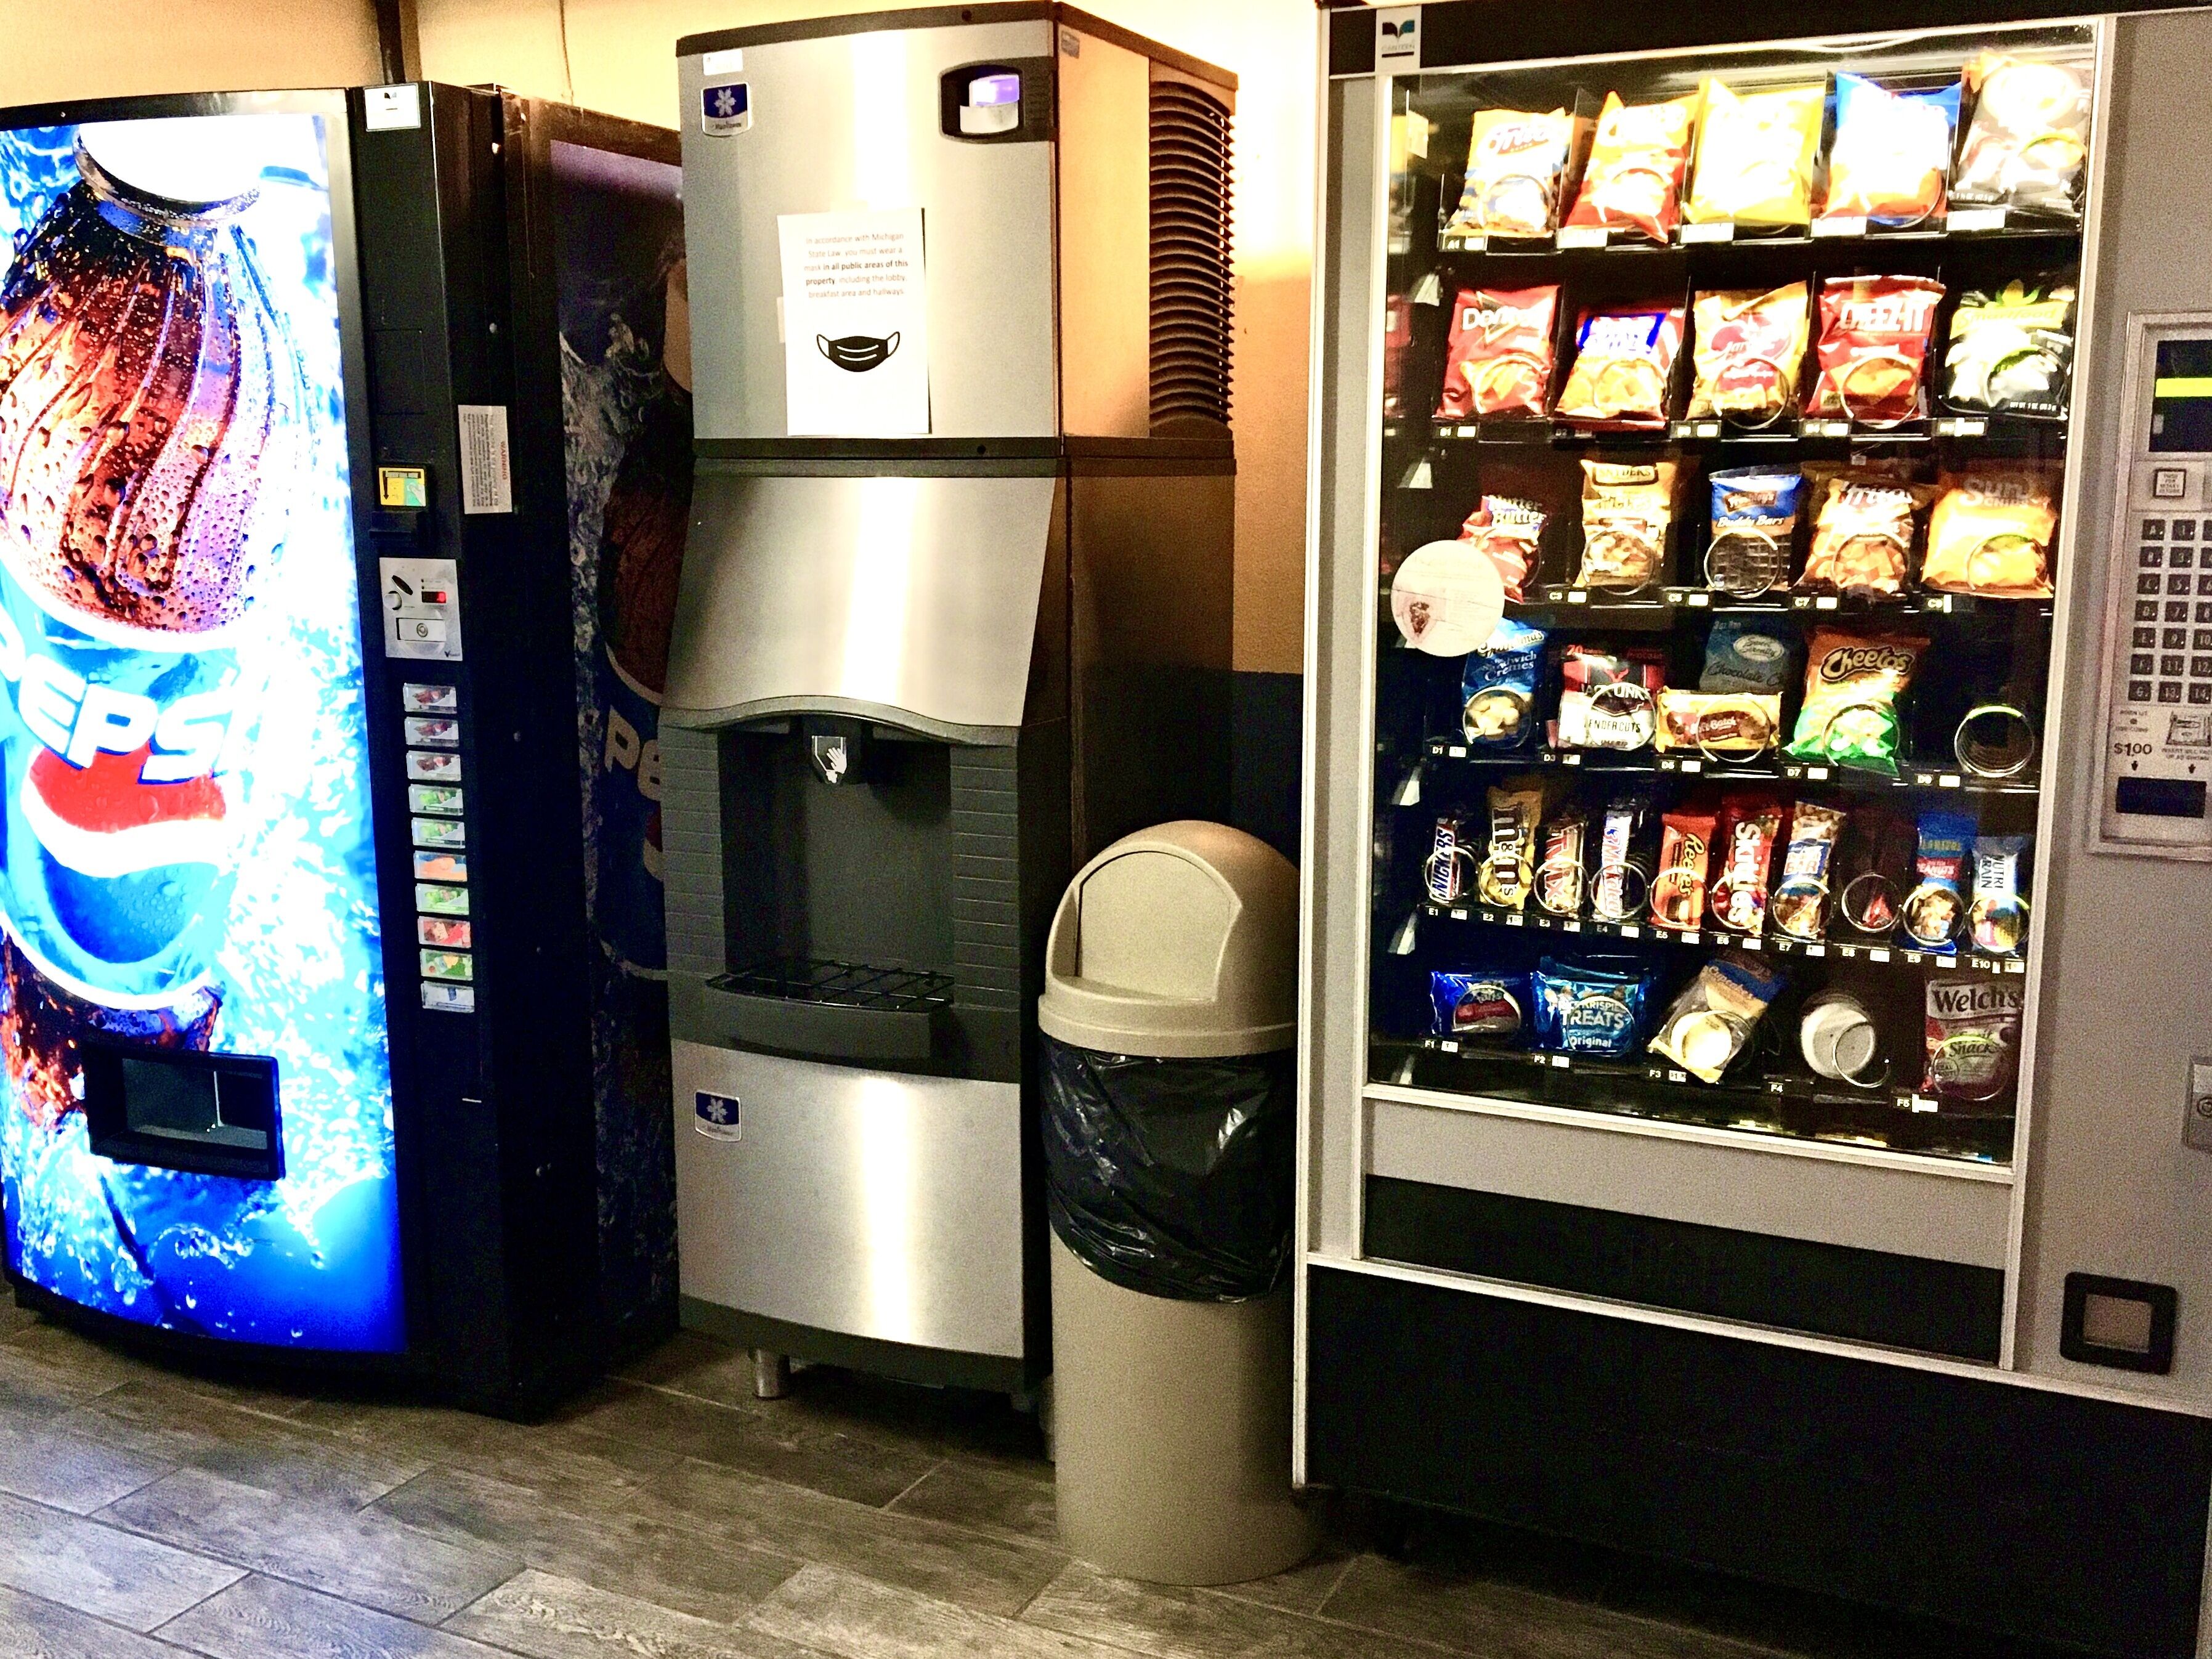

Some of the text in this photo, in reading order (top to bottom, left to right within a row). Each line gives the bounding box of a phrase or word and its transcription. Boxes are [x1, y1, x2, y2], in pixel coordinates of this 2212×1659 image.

[814, 235, 853, 245] accordance
[854, 234, 870, 242] with
[872, 232, 904, 243] Michigan
[808, 249, 826, 258] State
[845, 249, 858, 258] you
[859, 248, 877, 256] must
[803, 264, 822, 272] mask
[823, 263, 830, 271] in
[831, 262, 840, 270] all
[841, 261, 862, 272] public
[885, 259, 894, 268] of
[894, 259, 909, 267] this
[838, 275, 870, 285] including
[872, 274, 884, 282] the
[808, 290, 840, 299] breakfast
[841, 290, 856, 298] area
[858, 288, 872, 296] and
[1956, 307, 2057, 329] Smartfood
[500, 440, 508, 481] WARNING
[1838, 481, 1913, 506] Fritos
[1958, 478, 2028, 506] Sun
[1488, 494, 1543, 513] Nutter
[1491, 508, 1547, 527] Butter
[1717, 514, 1785, 528] Buddy Bars
[1481, 651, 1537, 673] Sandwich
[1820, 646, 1914, 681] Cheetos
[1484, 661, 1534, 681] Cremes
[1707, 662, 1764, 683] Chocolate
[1621, 721, 1645, 734] CUTS
[1710, 716, 1737, 729] Batch
[1432, 746, 1444, 755] D1
[2113, 742, 2152, 756] $1.00
[1544, 753, 1556, 762] D3
[1679, 833, 1706, 898] Reee's
[1991, 854, 2005, 889] NUTRI
[1727, 822, 1762, 923] Skittles
[1428, 907, 1438, 916] E1
[1483, 913, 1494, 922] E2
[1597, 924, 1608, 933] E4
[1779, 943, 1792, 951] E7
[1972, 959, 1990, 969] E10
[1560, 1009, 1625, 1030] TREATS
[1425, 1040, 1435, 1049] F1
[1569, 1036, 1612, 1049] Original
[1534, 1055, 1546, 1064] F2
[1650, 1069, 1661, 1078] F3
[1771, 1084, 1783, 1093] F4
